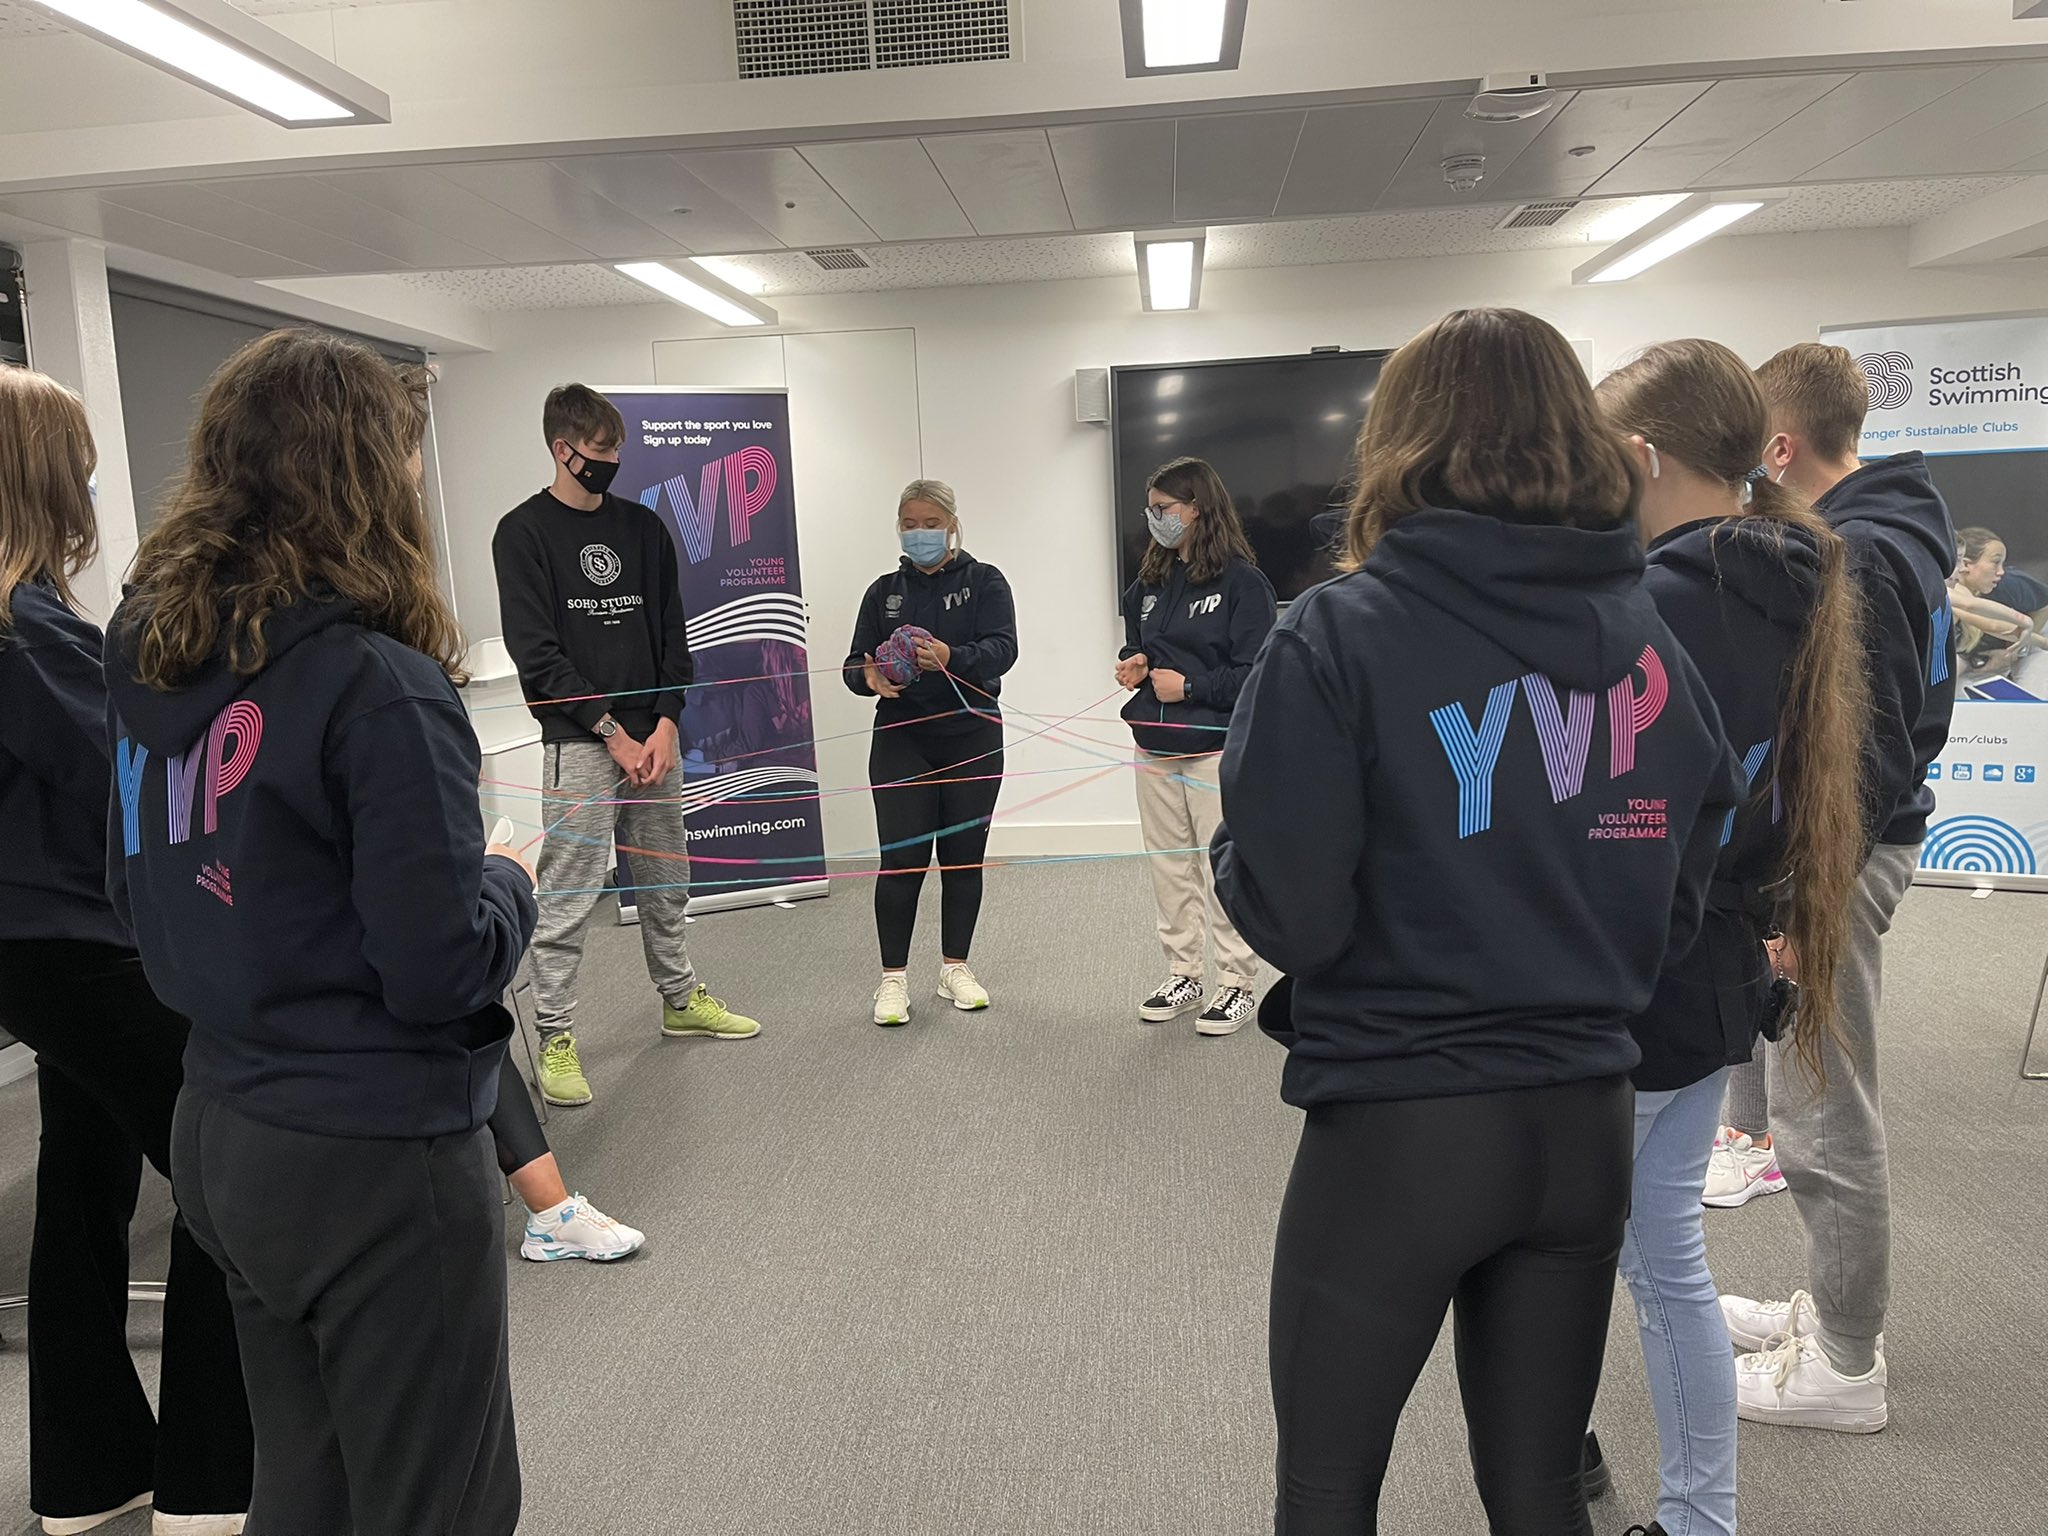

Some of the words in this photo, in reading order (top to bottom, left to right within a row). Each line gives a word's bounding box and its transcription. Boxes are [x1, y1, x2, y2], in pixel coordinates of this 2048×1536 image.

[1929, 362, 2021, 385] Scottish
[1928, 383, 2048, 406] Swimming
[641, 420, 683, 432] Support
[684, 420, 702, 431] the
[703, 420, 731, 432] sport
[731, 421, 750, 431] you
[752, 420, 773, 430] love
[1860, 430, 1901, 441] onger
[1905, 423, 1978, 438] Sustainable
[1982, 421, 2019, 433] Clubs
[643, 434, 666, 447] Sign
[667, 436, 682, 446] up
[683, 434, 712, 446] today
[749, 557, 785, 567] YOUNG
[725, 567, 785, 577] VOLUNTEER
[720, 576, 786, 587] PROGRAMME
[567, 598, 599, 609] SOHO
[600, 595, 643, 608] STUDIO
[1188, 593, 1222, 620] YVP
[1429, 644, 1669, 840] YVP
[116, 699, 264, 858] YVP
[1627, 798, 1667, 810] YOUNG
[1598, 813, 1667, 825] VOLUNTEER
[1588, 827, 1667, 840] PROGRAMME
